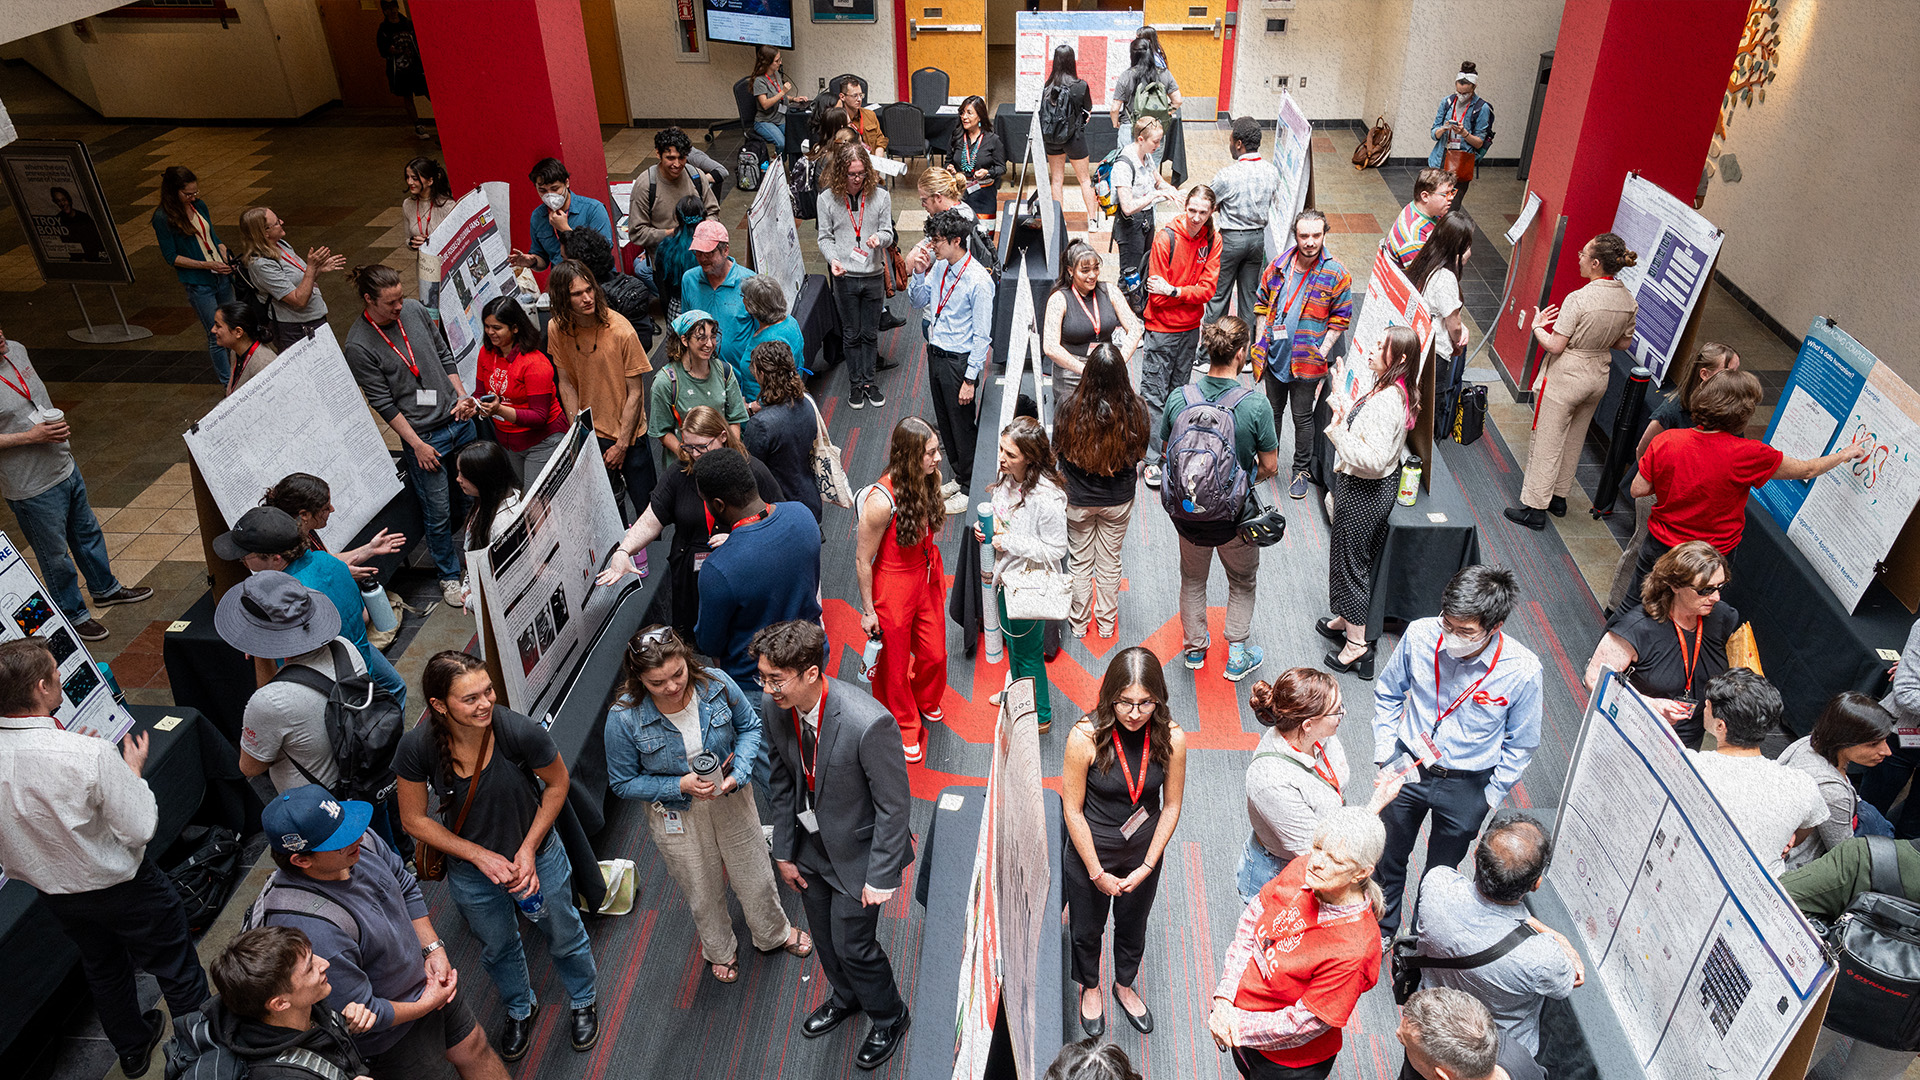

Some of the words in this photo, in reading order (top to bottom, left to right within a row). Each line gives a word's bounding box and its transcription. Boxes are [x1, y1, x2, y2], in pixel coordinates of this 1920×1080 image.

[32, 216, 61, 226] TROY
[37, 226, 69, 236] BOND
[1807, 339, 1820, 352] What
[1824, 350, 1834, 362] data
[1833, 358, 1855, 379] humanism?
[204, 418, 218, 431] Glacier
[1818, 540, 1838, 566] Application
[1840, 566, 1859, 589] Research
[1682, 768, 1701, 794] Carriers
[1700, 794, 1708, 804] for
[1706, 804, 1720, 821] Dual
[1718, 822, 1738, 850] Therapy
[1737, 850, 1746, 862] for
[1744, 862, 1773, 900] Peritoneal
[1771, 899, 1796, 932] Ovarian
[1794, 931, 1816, 961] Cancer
[1257, 924, 1279, 973] UOC
